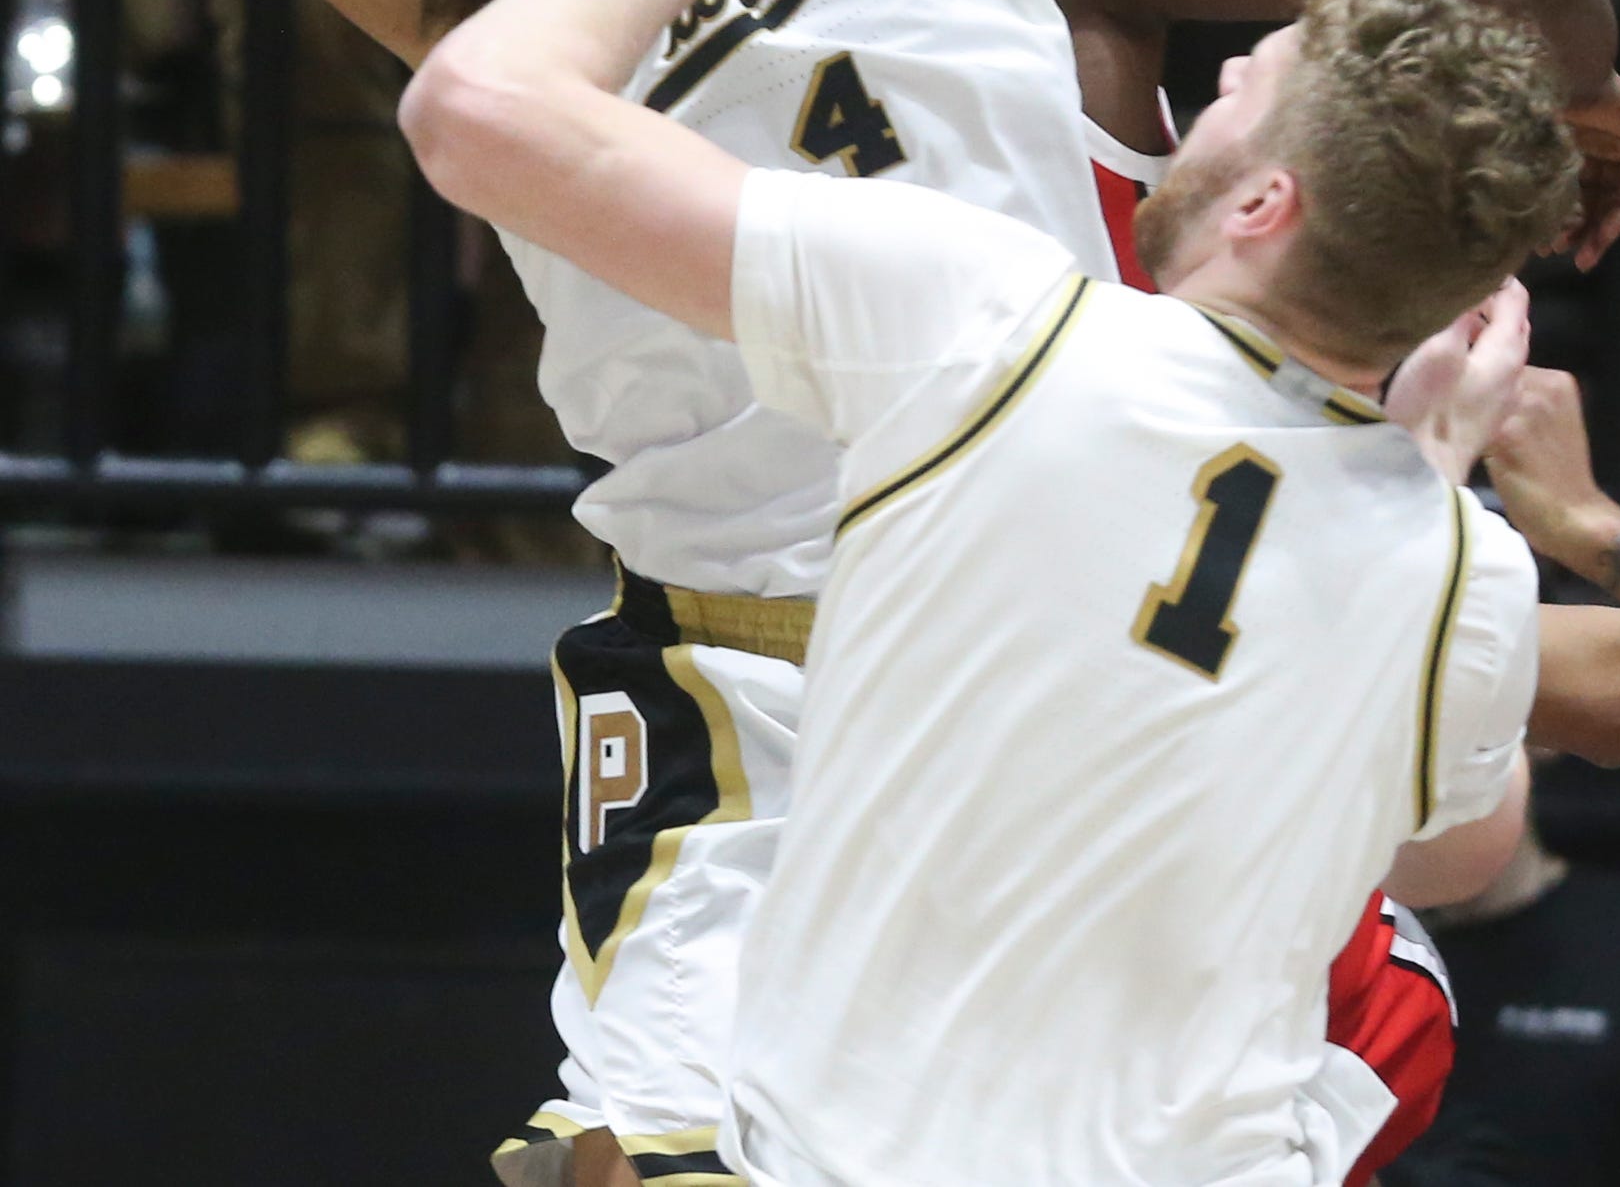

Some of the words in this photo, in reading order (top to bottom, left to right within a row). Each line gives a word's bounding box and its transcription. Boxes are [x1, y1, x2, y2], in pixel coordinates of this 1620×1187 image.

[788, 50, 910, 178] 4
[1128, 440, 1285, 685] 1
[578, 690, 650, 856] P
